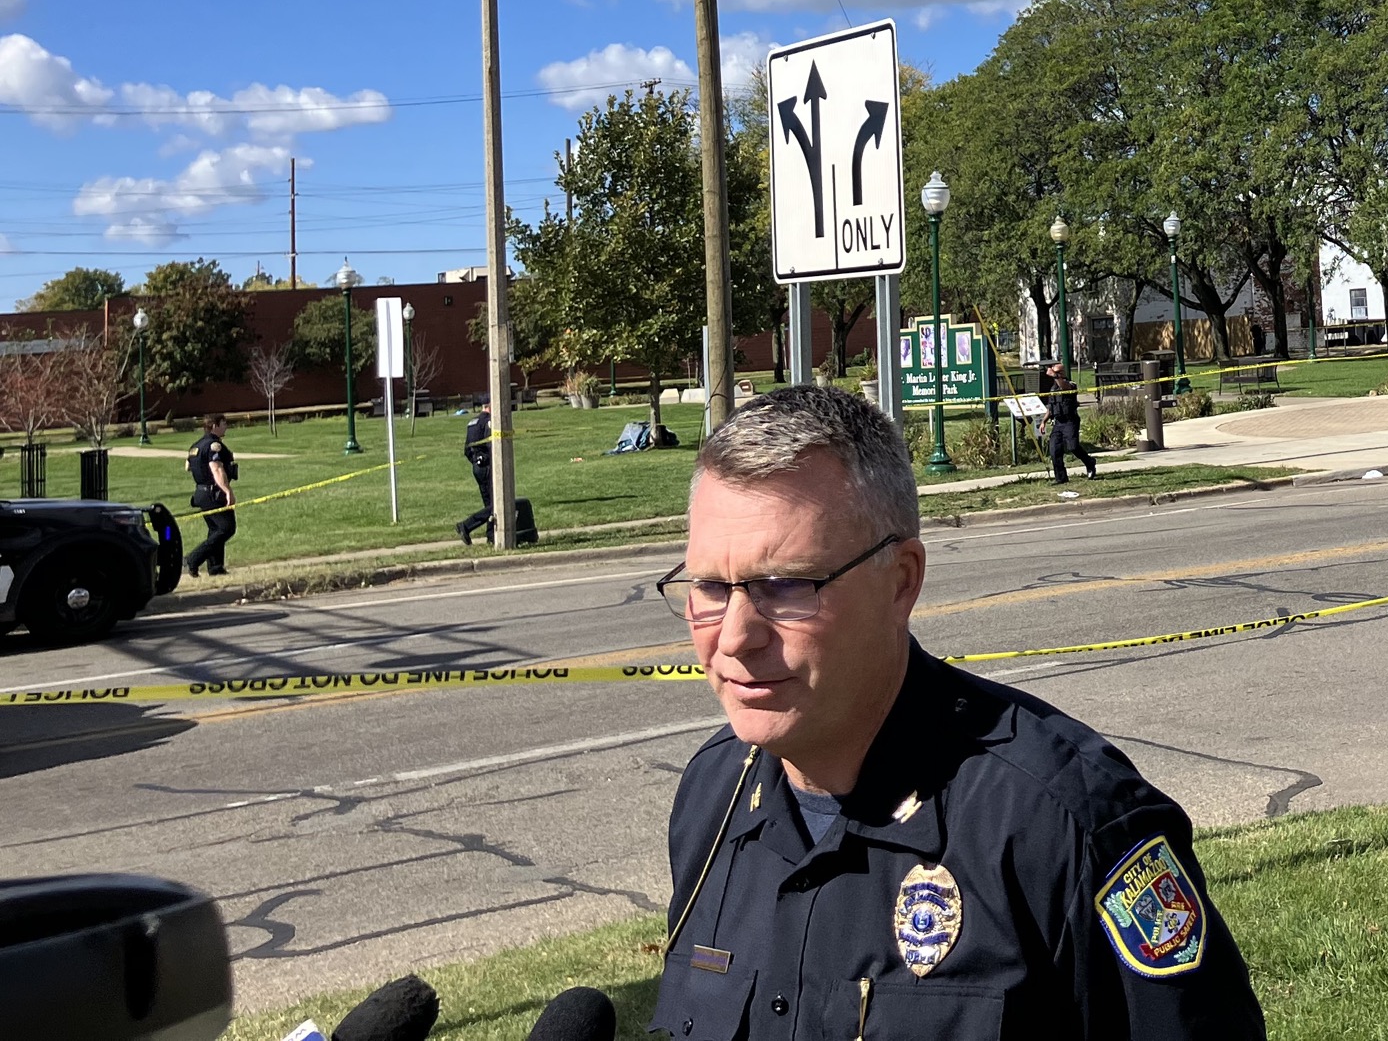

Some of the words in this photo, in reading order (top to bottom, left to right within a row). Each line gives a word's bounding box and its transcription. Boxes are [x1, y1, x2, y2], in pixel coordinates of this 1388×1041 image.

[842, 212, 894, 254] ONLY
[906, 372, 928, 384] Martin
[950, 370, 967, 383] King
[968, 369, 977, 383] Jr.
[912, 384, 936, 396] Memori
[942, 383, 958, 395] Park
[1123, 862, 1142, 884] CITY
[1142, 852, 1152, 866] OF
[1120, 858, 1167, 909] KALAMAZOO
[1153, 937, 1181, 957] PUBLIC
